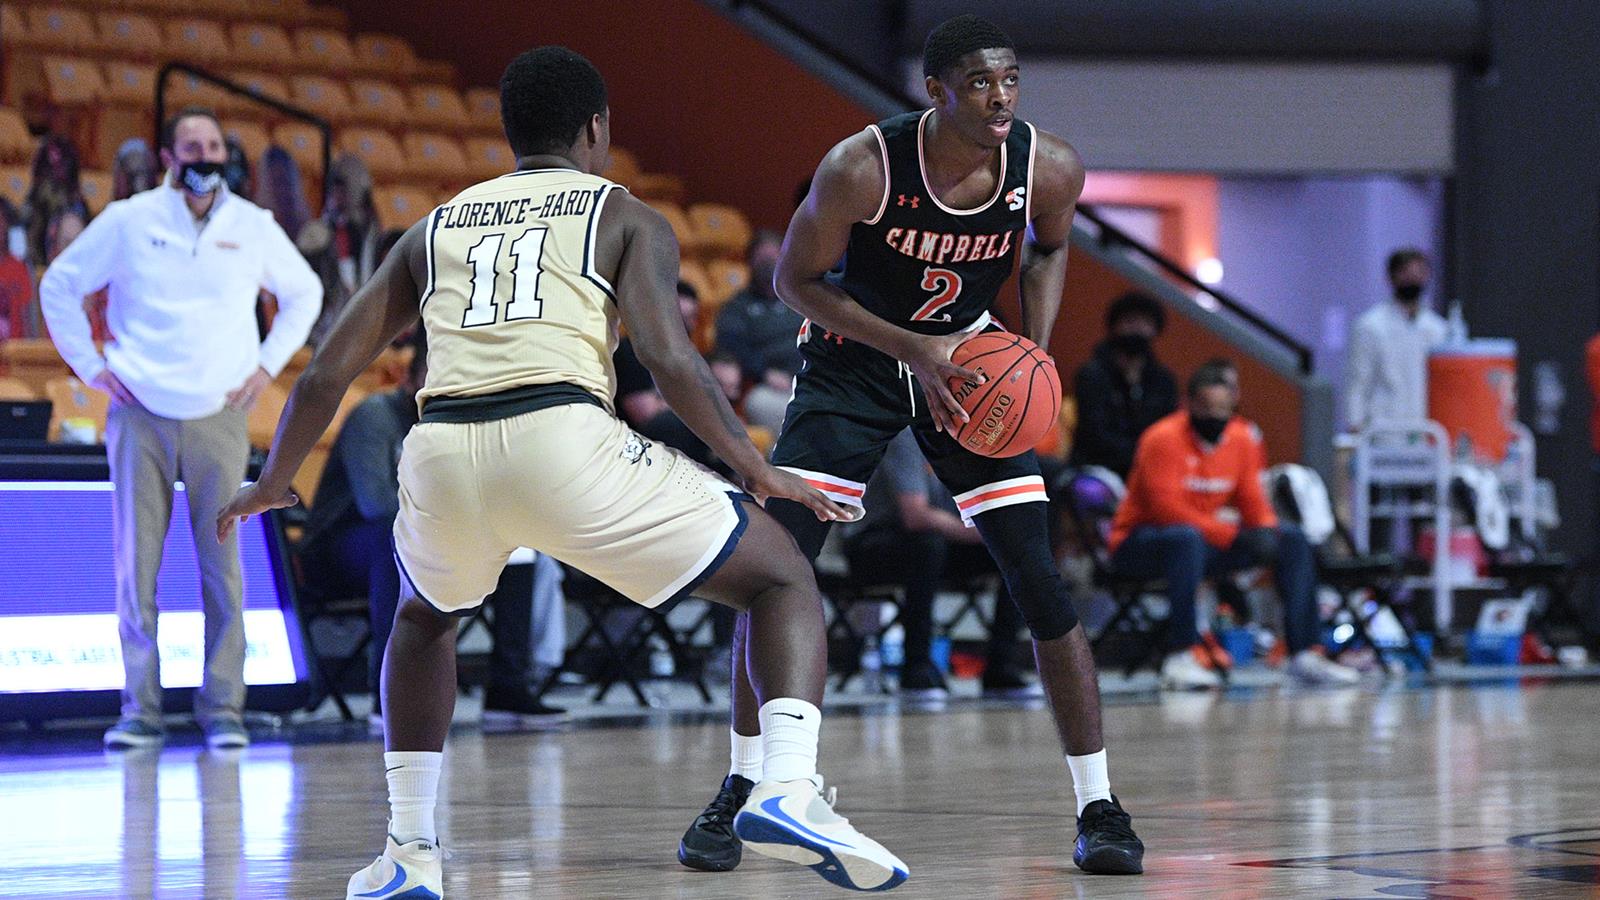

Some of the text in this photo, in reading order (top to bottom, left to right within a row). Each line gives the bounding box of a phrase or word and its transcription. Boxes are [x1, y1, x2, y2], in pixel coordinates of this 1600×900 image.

[435, 190, 605, 229] FLORENCE-HARDY
[886, 227, 1013, 264] CAMPBELL
[461, 227, 549, 328] 11
[909, 265, 963, 322] 2
